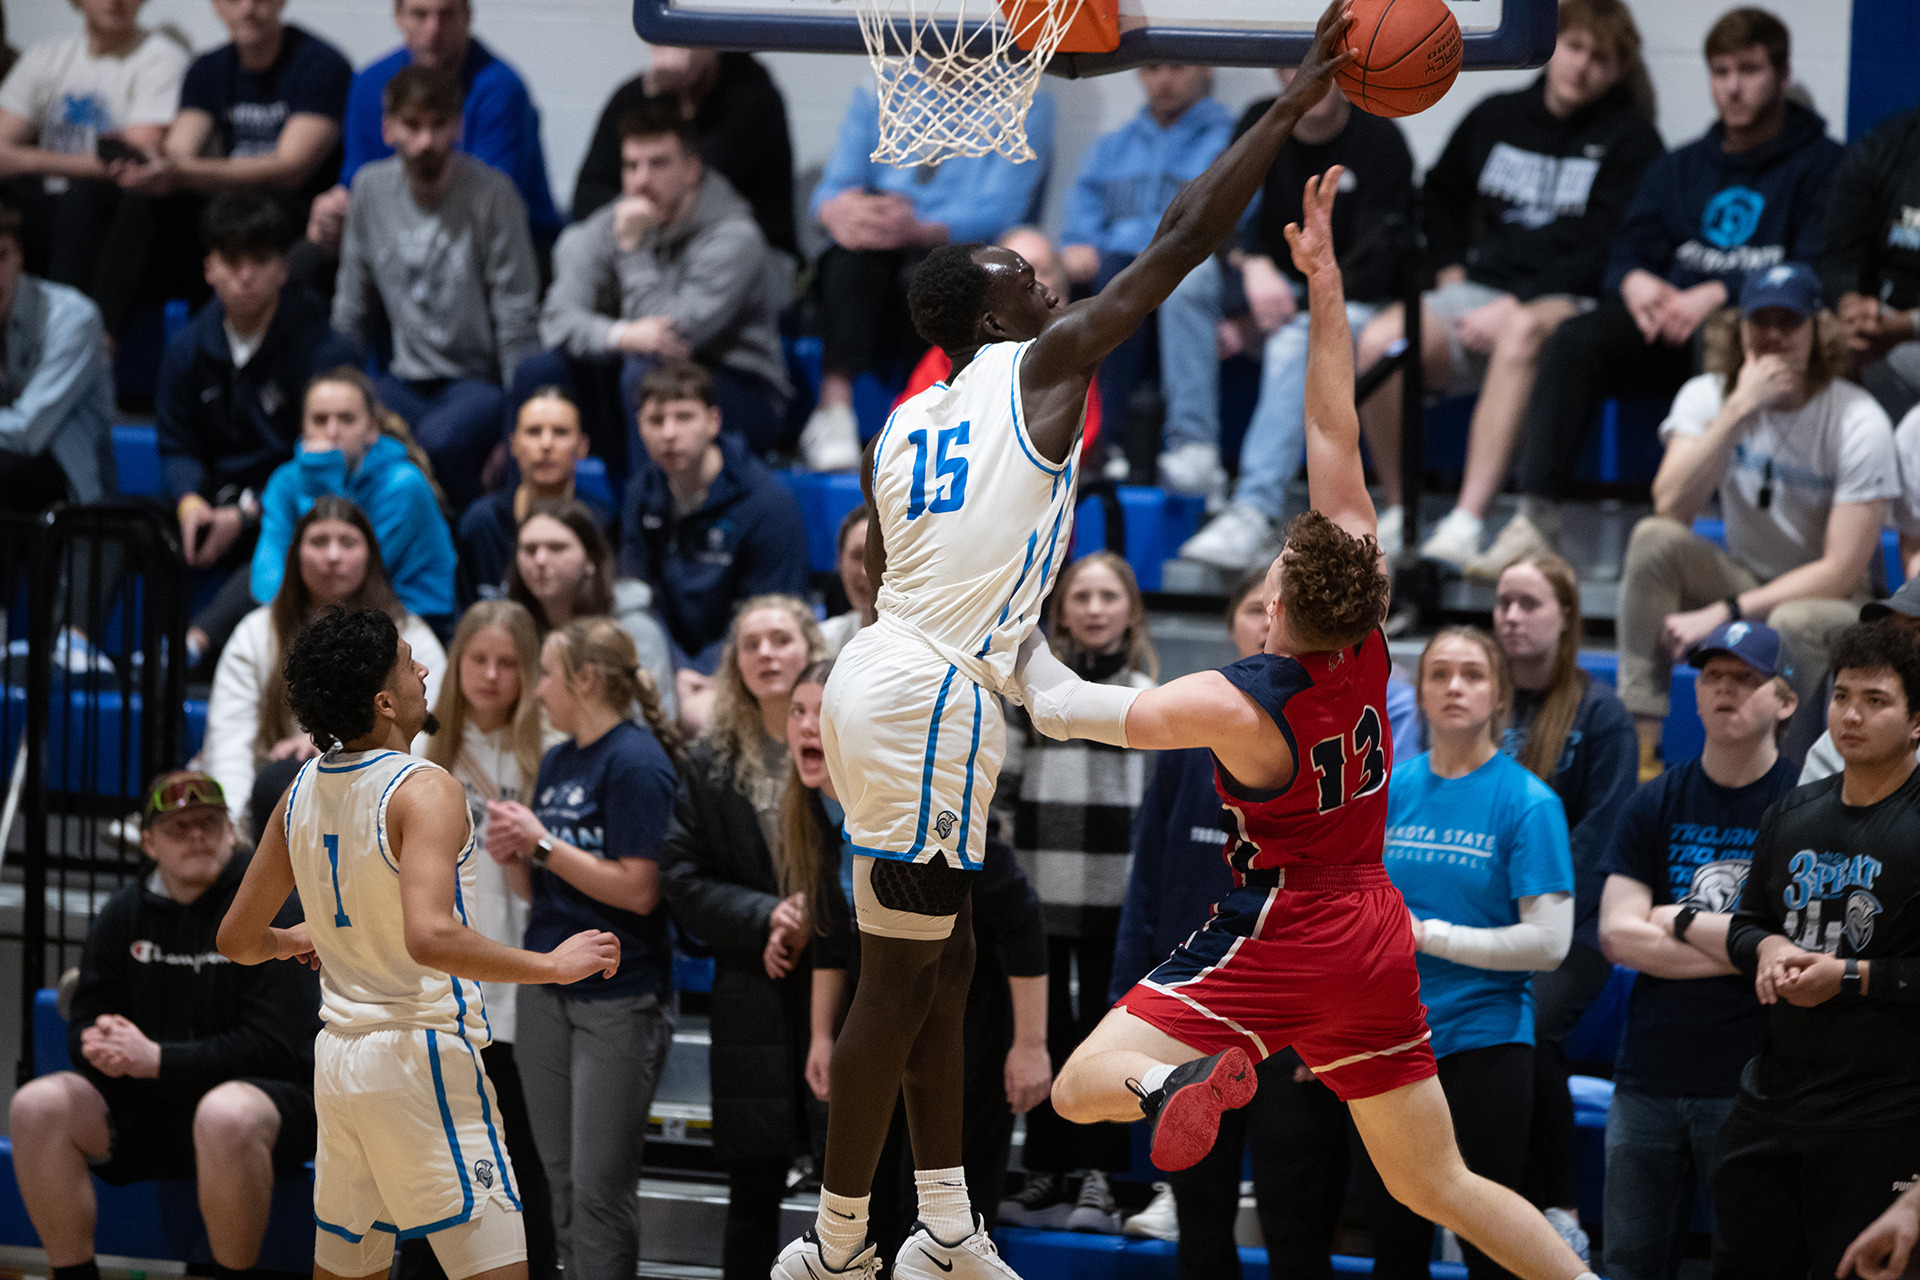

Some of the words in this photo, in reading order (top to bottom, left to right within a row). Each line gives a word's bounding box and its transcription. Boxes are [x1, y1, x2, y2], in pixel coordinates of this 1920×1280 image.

[906, 420, 970, 520] 15
[1310, 704, 1387, 816] 13
[323, 833, 352, 928] 1
[1442, 829, 1496, 851] STATE
